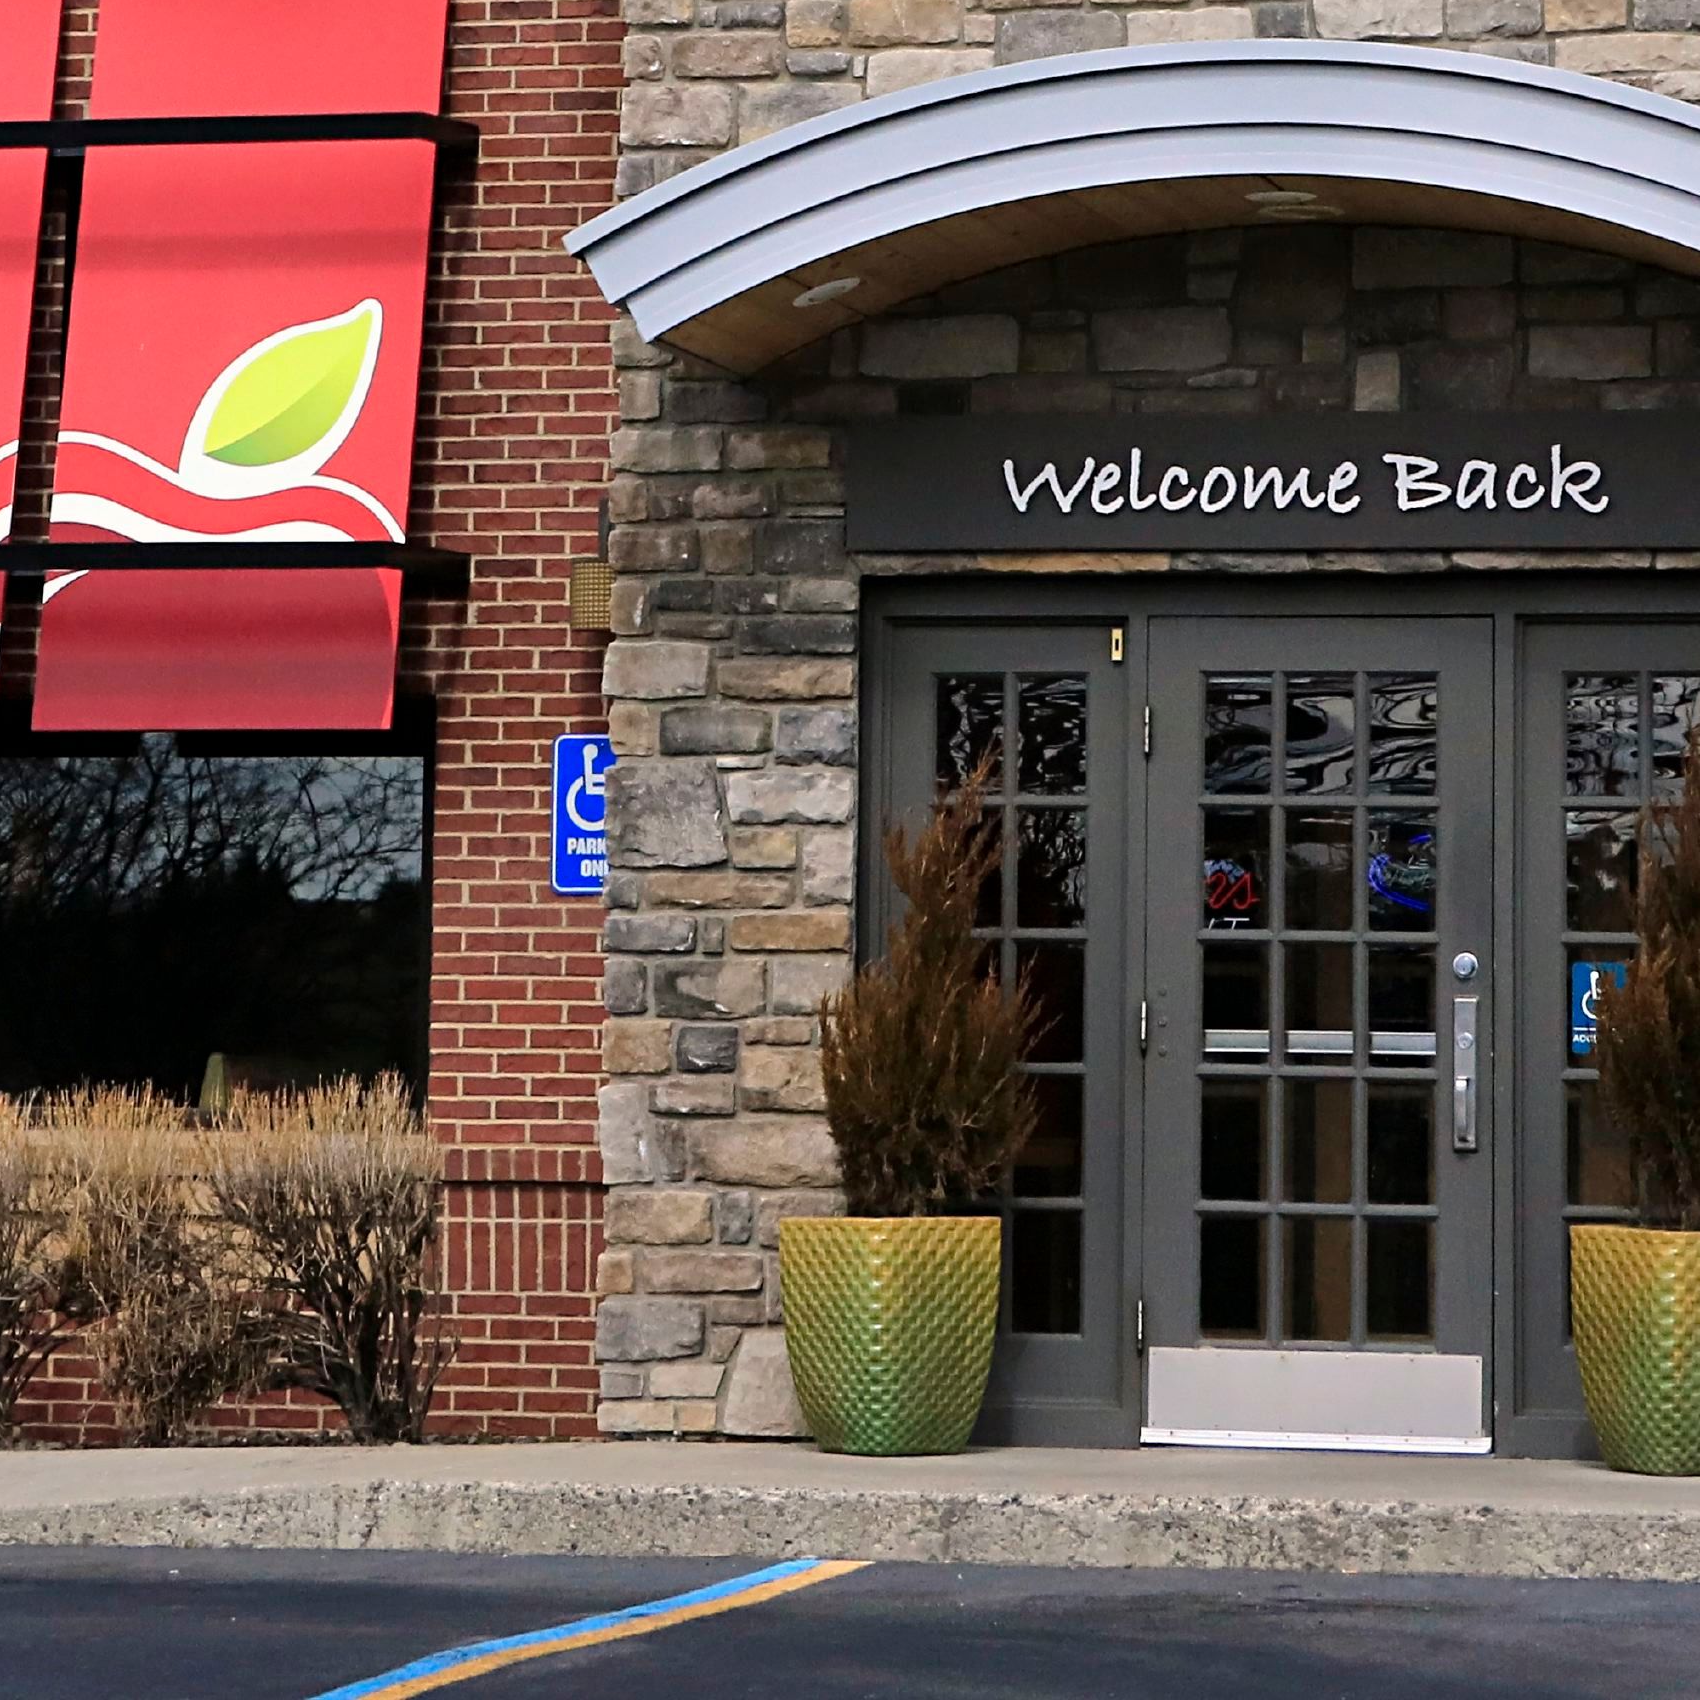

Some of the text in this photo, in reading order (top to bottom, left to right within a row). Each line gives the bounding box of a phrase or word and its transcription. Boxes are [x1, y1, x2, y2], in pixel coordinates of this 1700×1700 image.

[1003, 443, 1610, 515] Welcome Back
[566, 837, 606, 855] PARK
